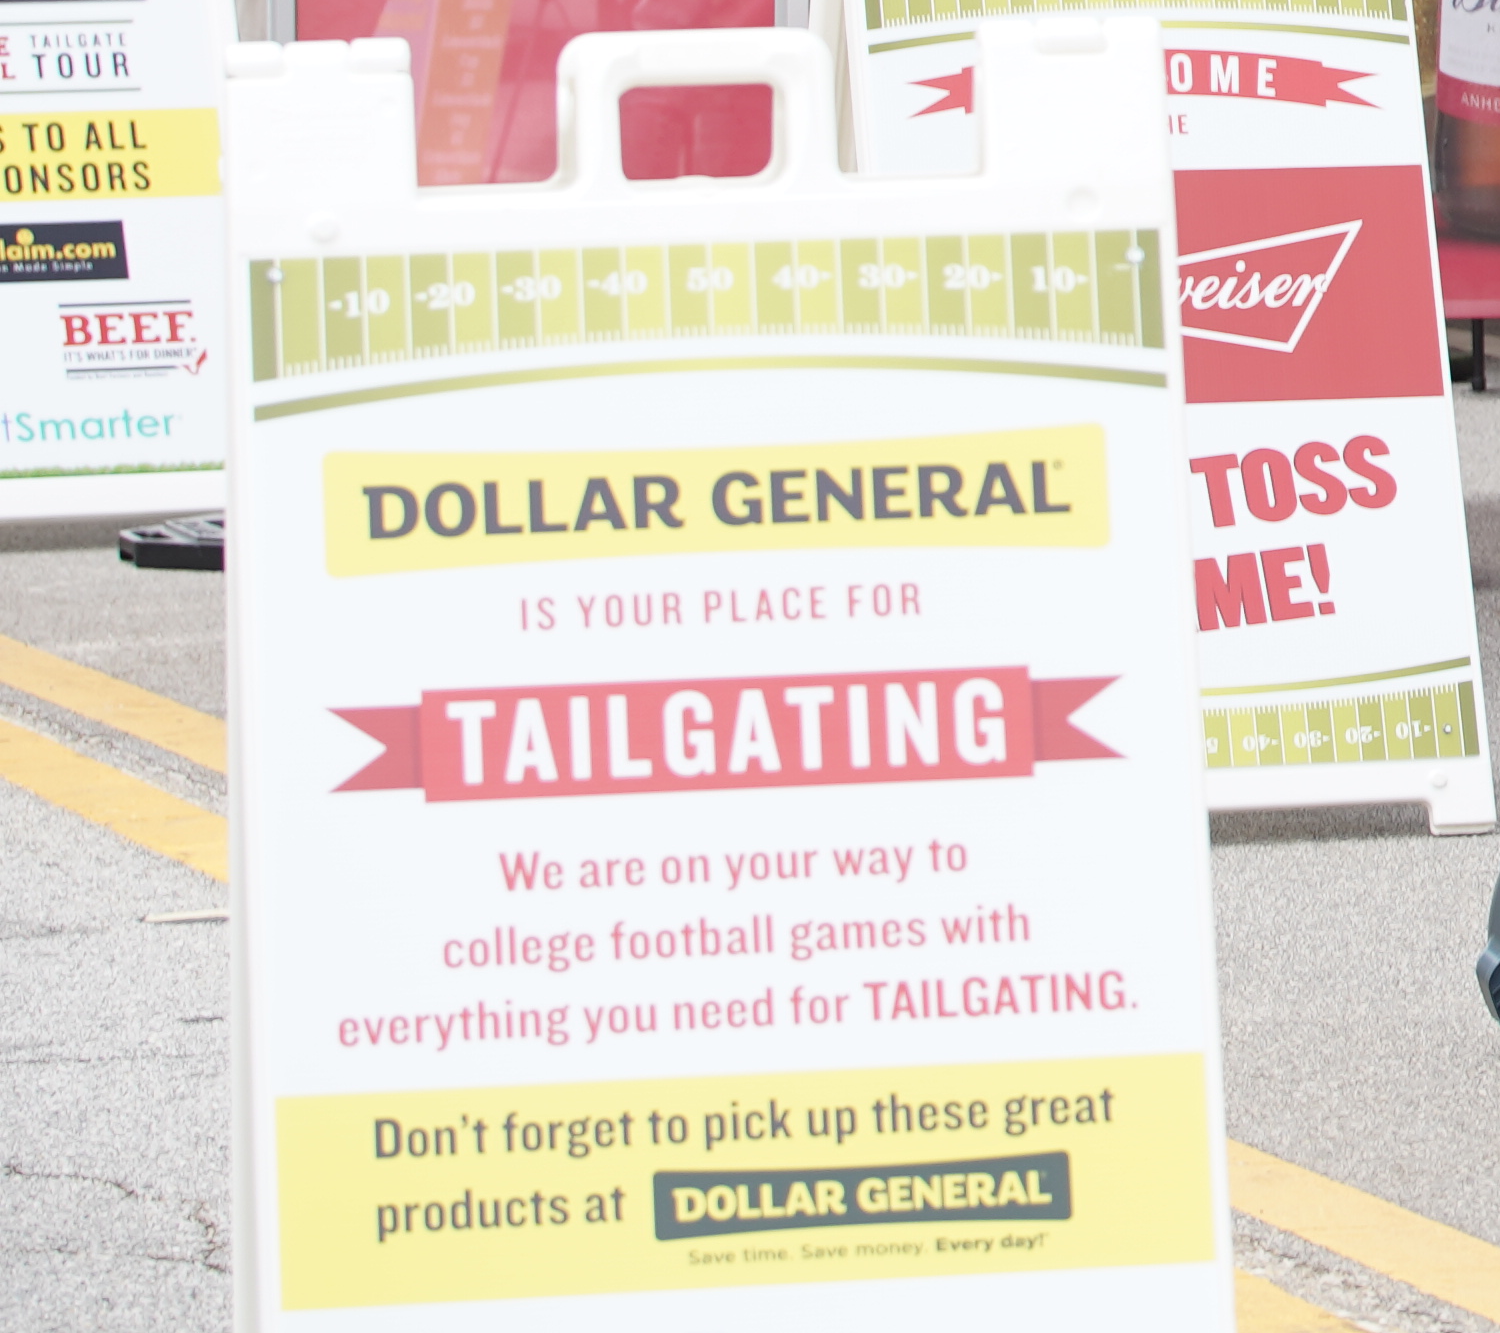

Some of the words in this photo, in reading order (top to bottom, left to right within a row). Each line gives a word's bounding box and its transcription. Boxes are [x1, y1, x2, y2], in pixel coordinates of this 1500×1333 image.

[29, 33, 127, 49] TAILGATE
[32, 52, 129, 80] TOUR
[362, 474, 685, 540] DOLLAR
[1188, 435, 1398, 527] TOSS
[520, 596, 556, 632] IS
[577, 591, 683, 629] YOUR
[703, 585, 827, 624] PLACE
[847, 582, 921, 618] FOR
[1194, 543, 1336, 632] ME!
[445, 677, 1007, 786] TAILGATING
[498, 850, 564, 892] We
[579, 857, 645, 889] are
[660, 854, 711, 885] on
[724, 849, 819, 891] your
[832, 846, 914, 884] way
[927, 838, 968, 873] to
[443, 925, 595, 974] college
[609, 913, 774, 961] football
[790, 918, 927, 962] games
[940, 902, 1030, 945] with
[338, 999, 570, 1052] everything
[583, 1003, 658, 1045] you
[673, 986, 774, 1031] need
[789, 985, 850, 1025] for
[862, 969, 1138, 1022] TAILGATING.
[373, 1113, 489, 1160] Don't
[501, 1111, 634, 1160] forget
[647, 1109, 689, 1146] to
[704, 1098, 793, 1152] pick
[807, 1106, 857, 1146] up
[871, 1092, 989, 1134] these
[1004, 1088, 1114, 1138] great
[376, 1188, 570, 1245] products
[584, 1186, 626, 1224] at
[671, 1180, 848, 1223] DOLLAR
